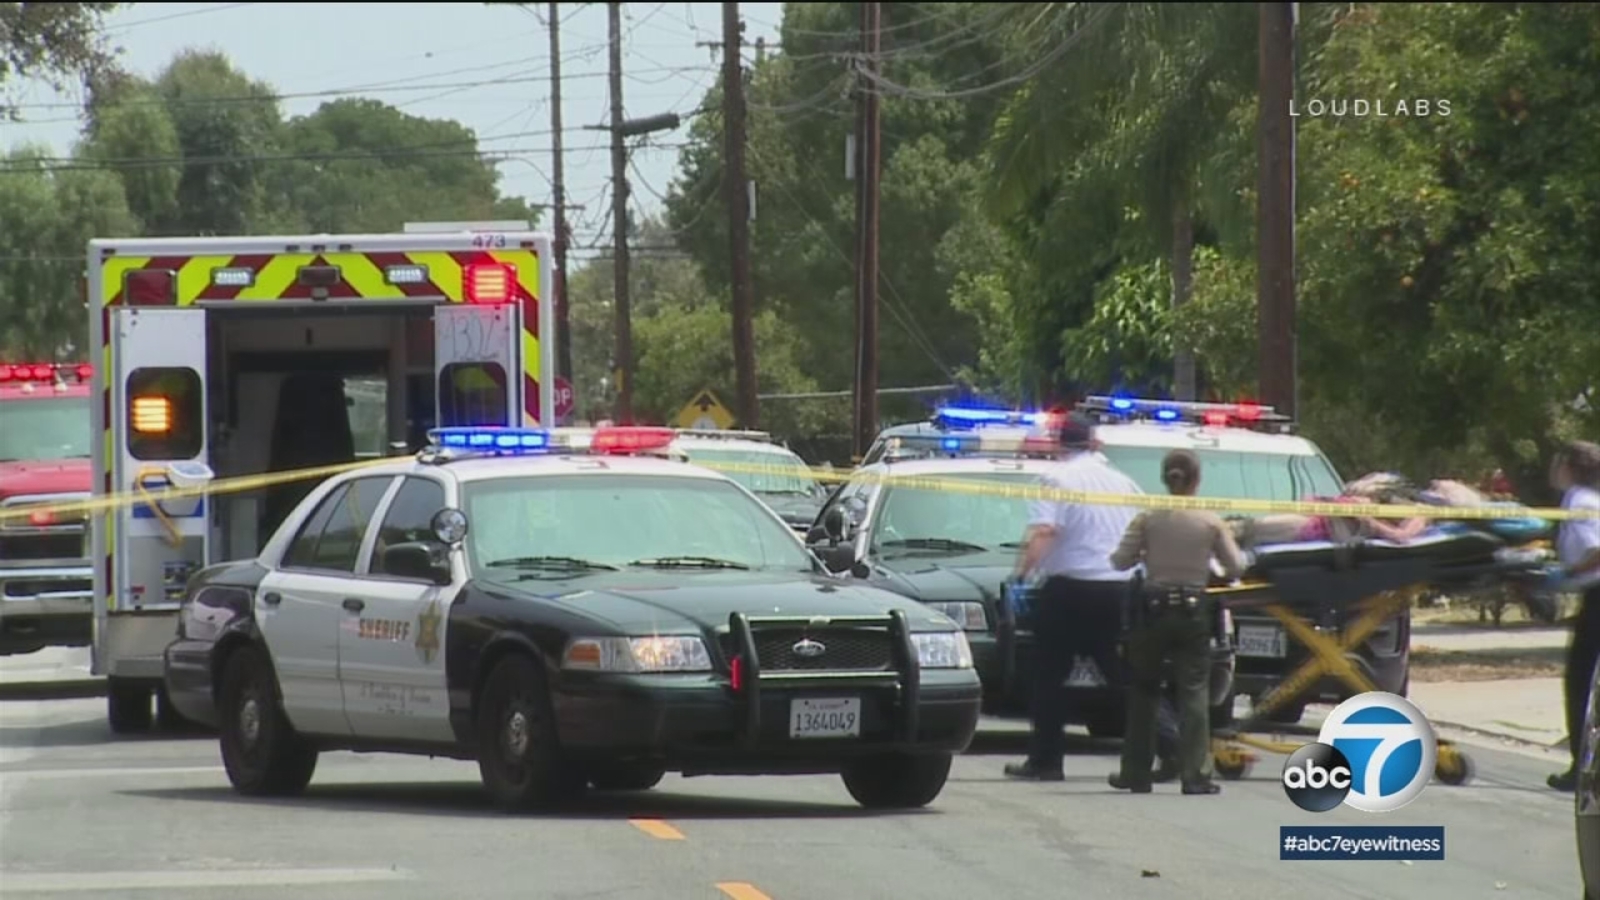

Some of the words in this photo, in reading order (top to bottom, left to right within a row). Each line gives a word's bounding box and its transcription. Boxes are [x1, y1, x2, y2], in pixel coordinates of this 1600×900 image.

[472, 234, 506, 248] 473
[359, 618, 411, 641] SHERIFF
[794, 712, 856, 731] 1364049
